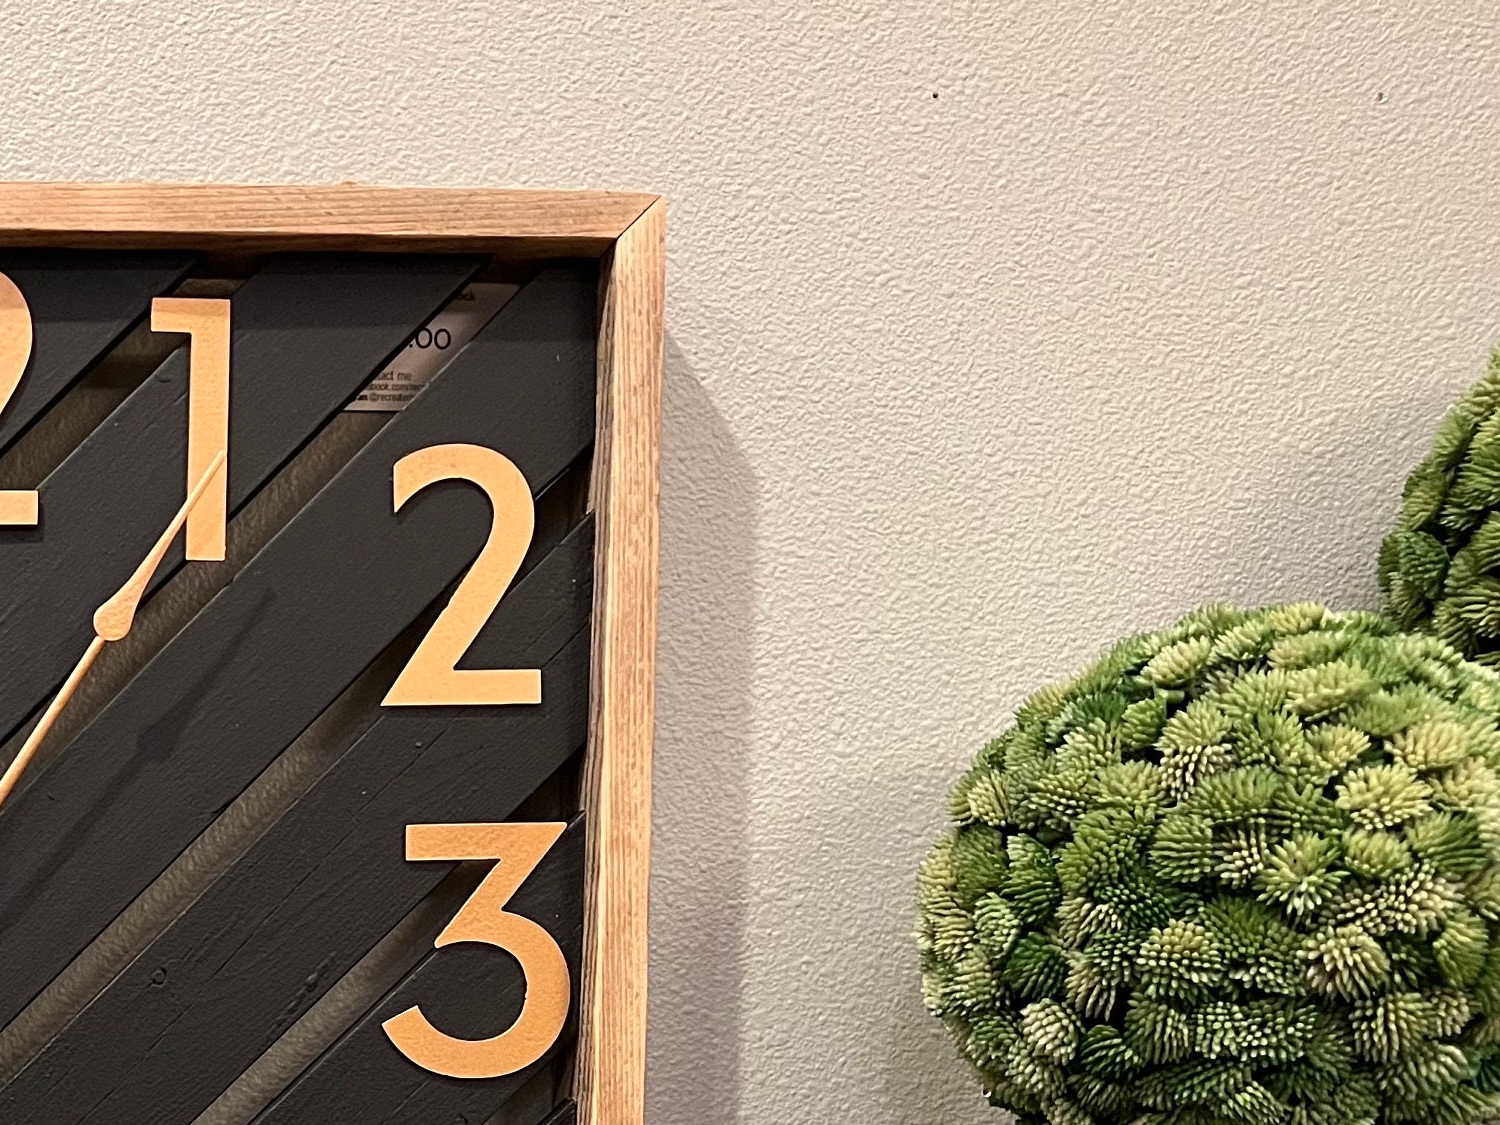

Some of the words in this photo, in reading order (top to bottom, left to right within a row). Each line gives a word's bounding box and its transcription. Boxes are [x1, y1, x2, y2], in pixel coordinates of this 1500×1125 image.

[151, 297, 231, 562] 1
[397, 372, 412, 381] me
[382, 443, 543, 706] 2
[382, 822, 571, 1080] 3
